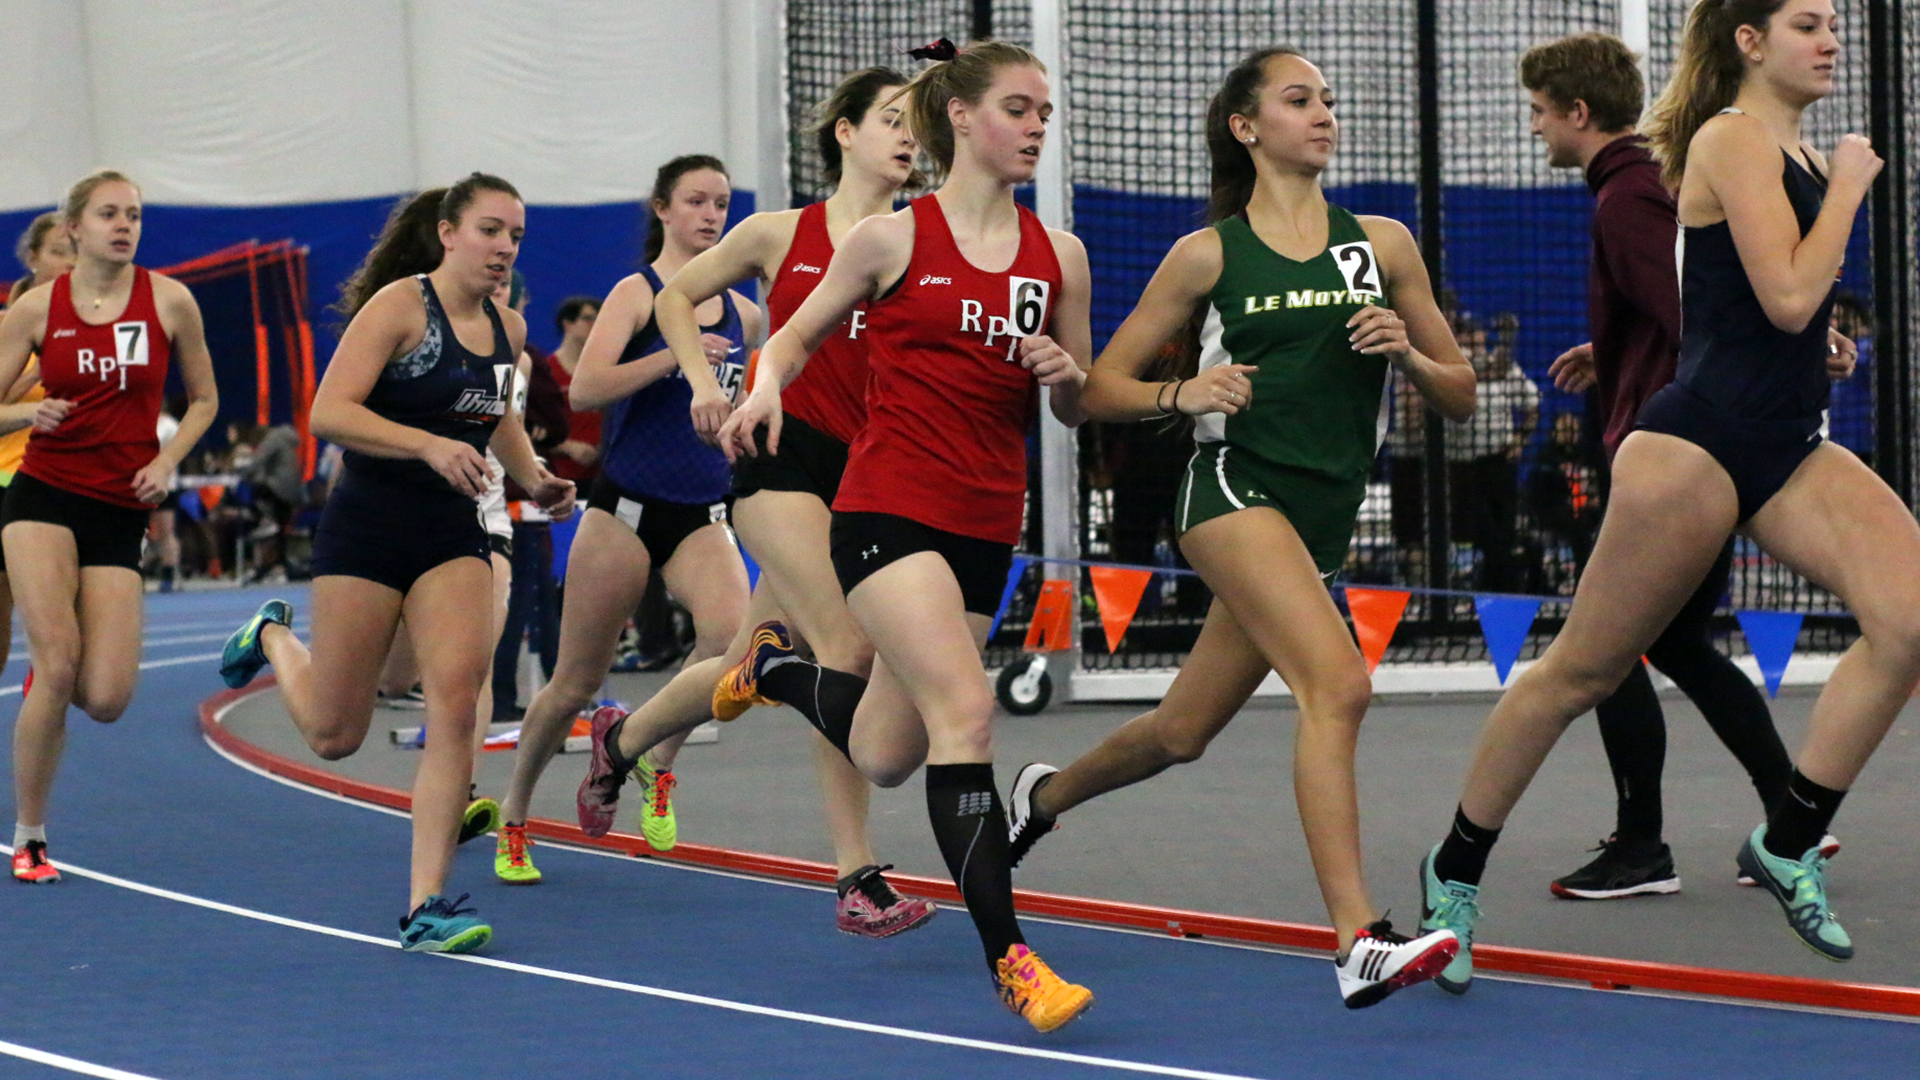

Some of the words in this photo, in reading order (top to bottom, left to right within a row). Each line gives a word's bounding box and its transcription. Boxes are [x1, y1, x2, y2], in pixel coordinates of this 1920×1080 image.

[1339, 245, 1379, 293] 2
[1015, 281, 1044, 336] 6
[1245, 296, 1281, 314] LE
[1286, 289, 1376, 308] MOYNE
[118, 325, 142, 361] 7
[960, 299, 1019, 362] RPI
[77, 348, 128, 391] RPI
[725, 367, 744, 404] 5
